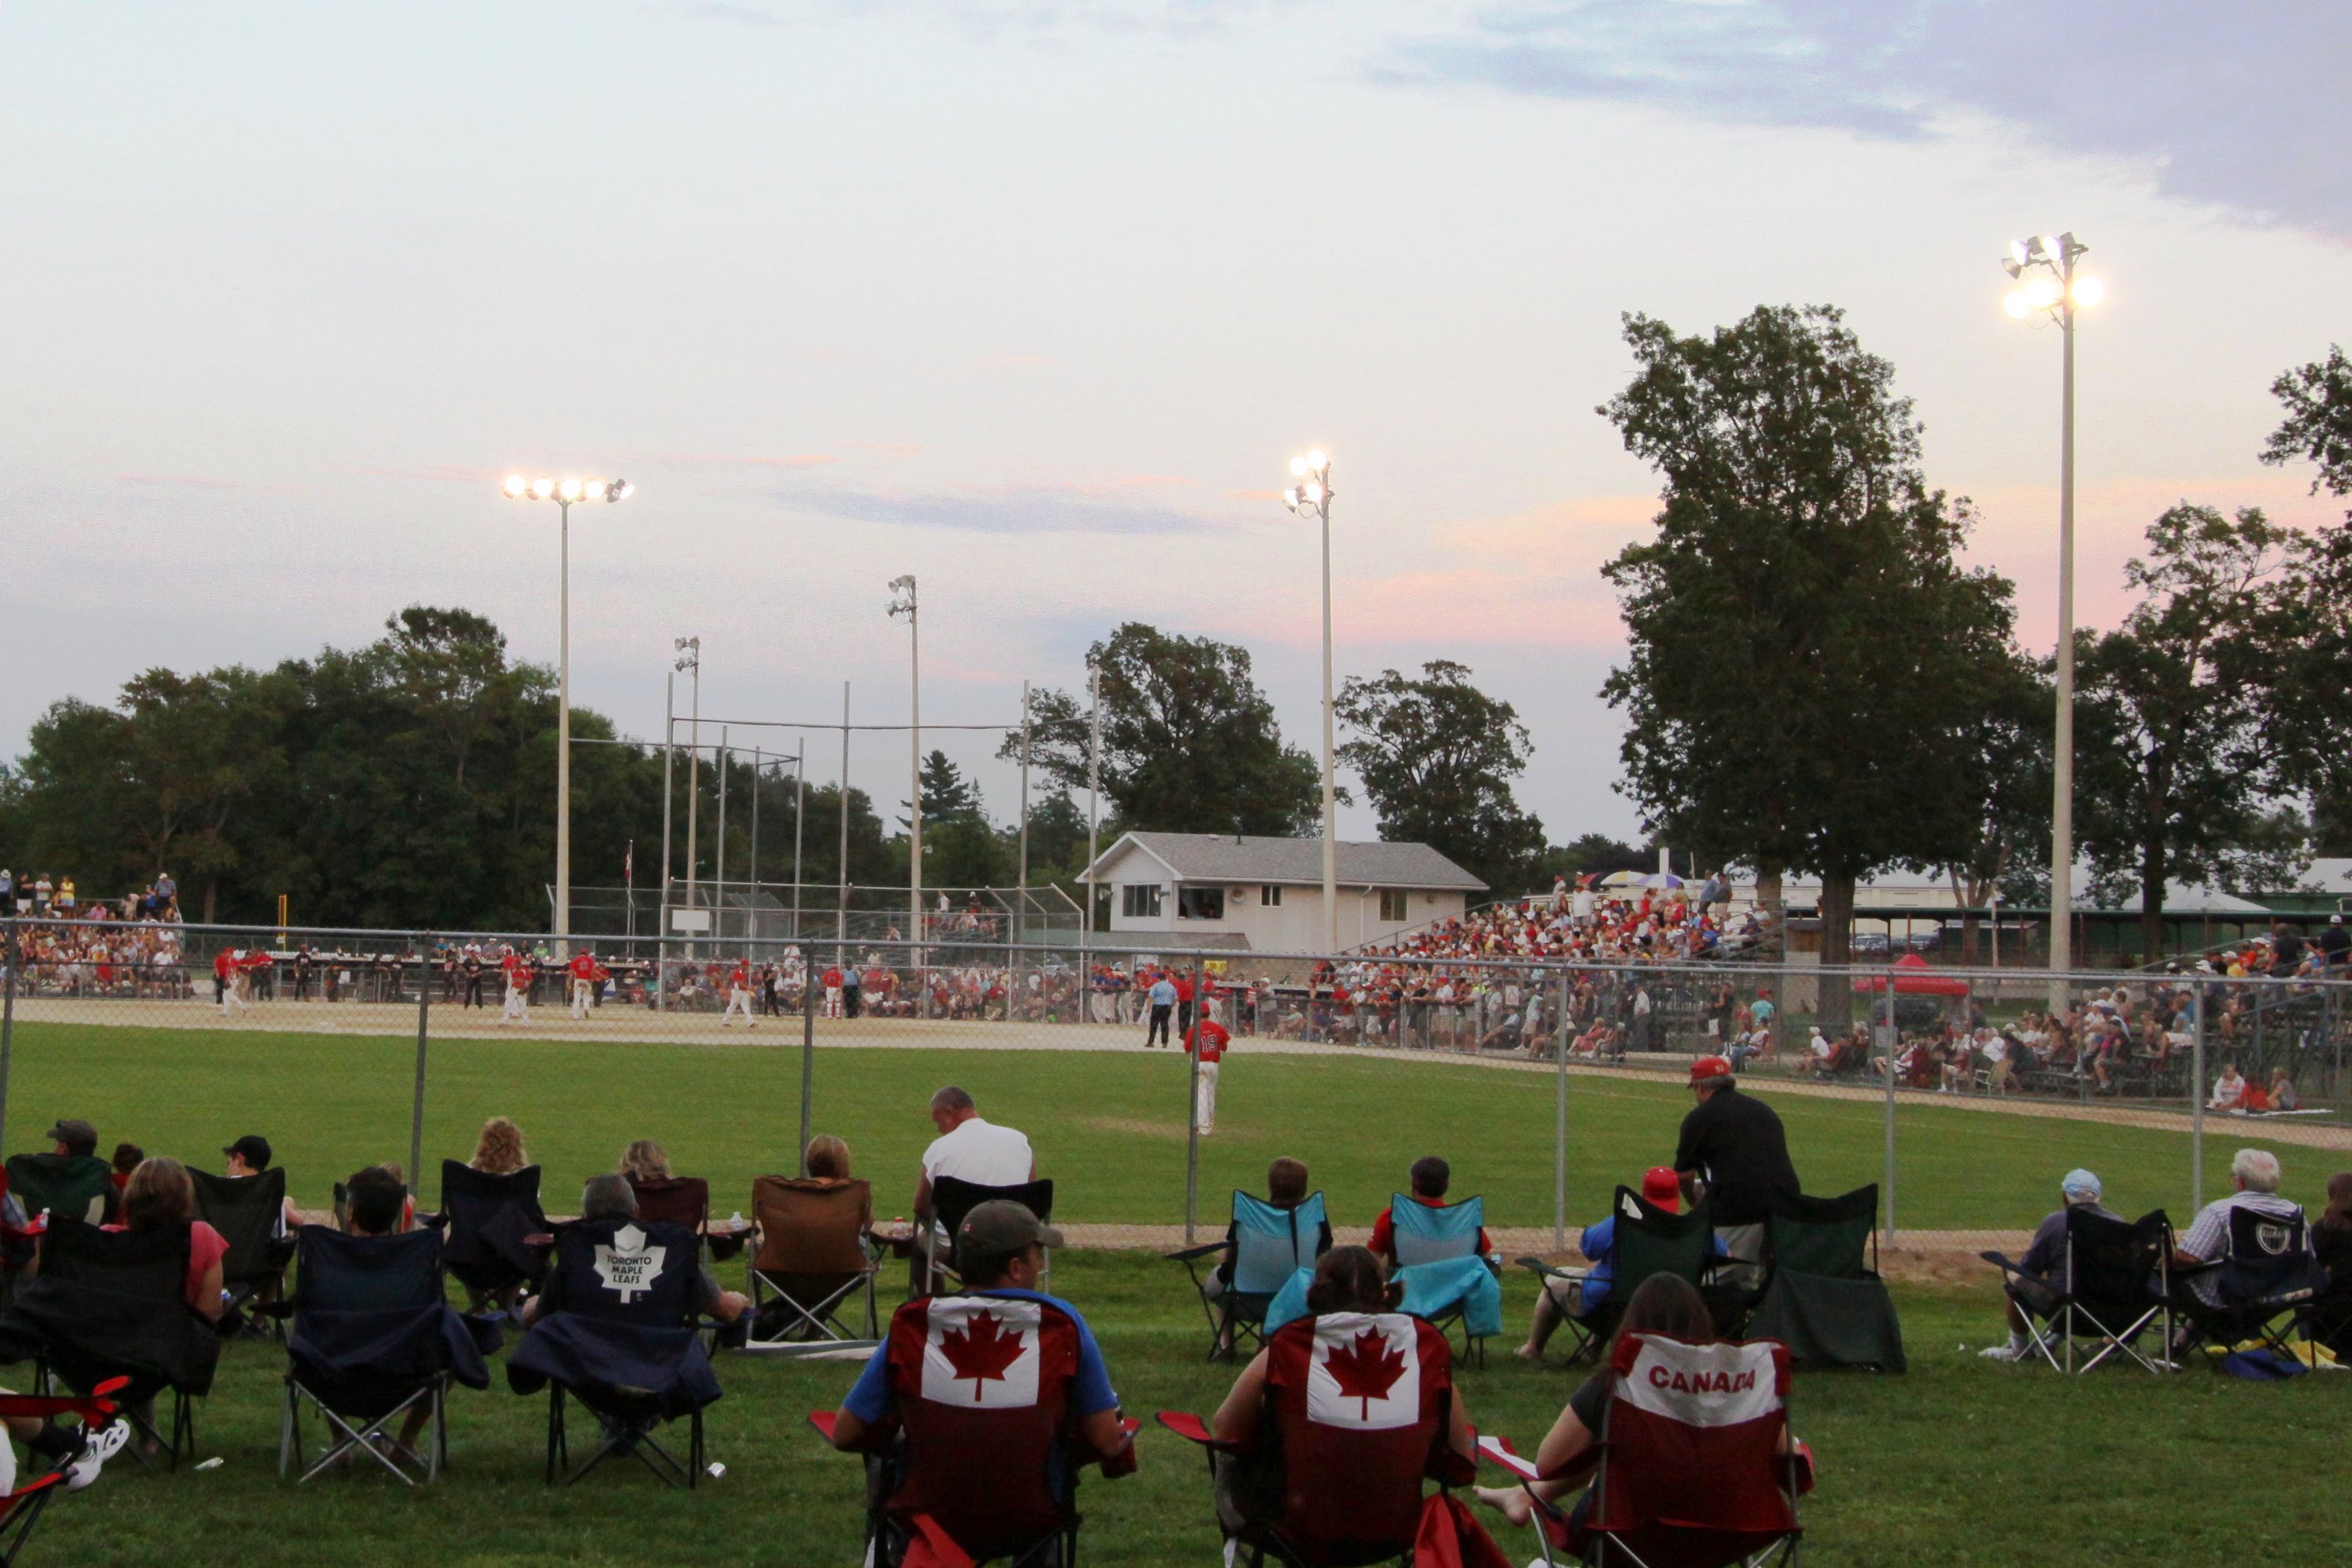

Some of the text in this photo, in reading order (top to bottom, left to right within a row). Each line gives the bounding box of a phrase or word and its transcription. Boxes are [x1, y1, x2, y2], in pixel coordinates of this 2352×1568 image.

[1201, 1034, 1218, 1052] 19
[607, 1255, 652, 1265] TORONTO
[612, 1266, 643, 1275] MAPLE
[613, 1275, 640, 1284] LEAFS
[1649, 1365, 1756, 1394] CANADA
